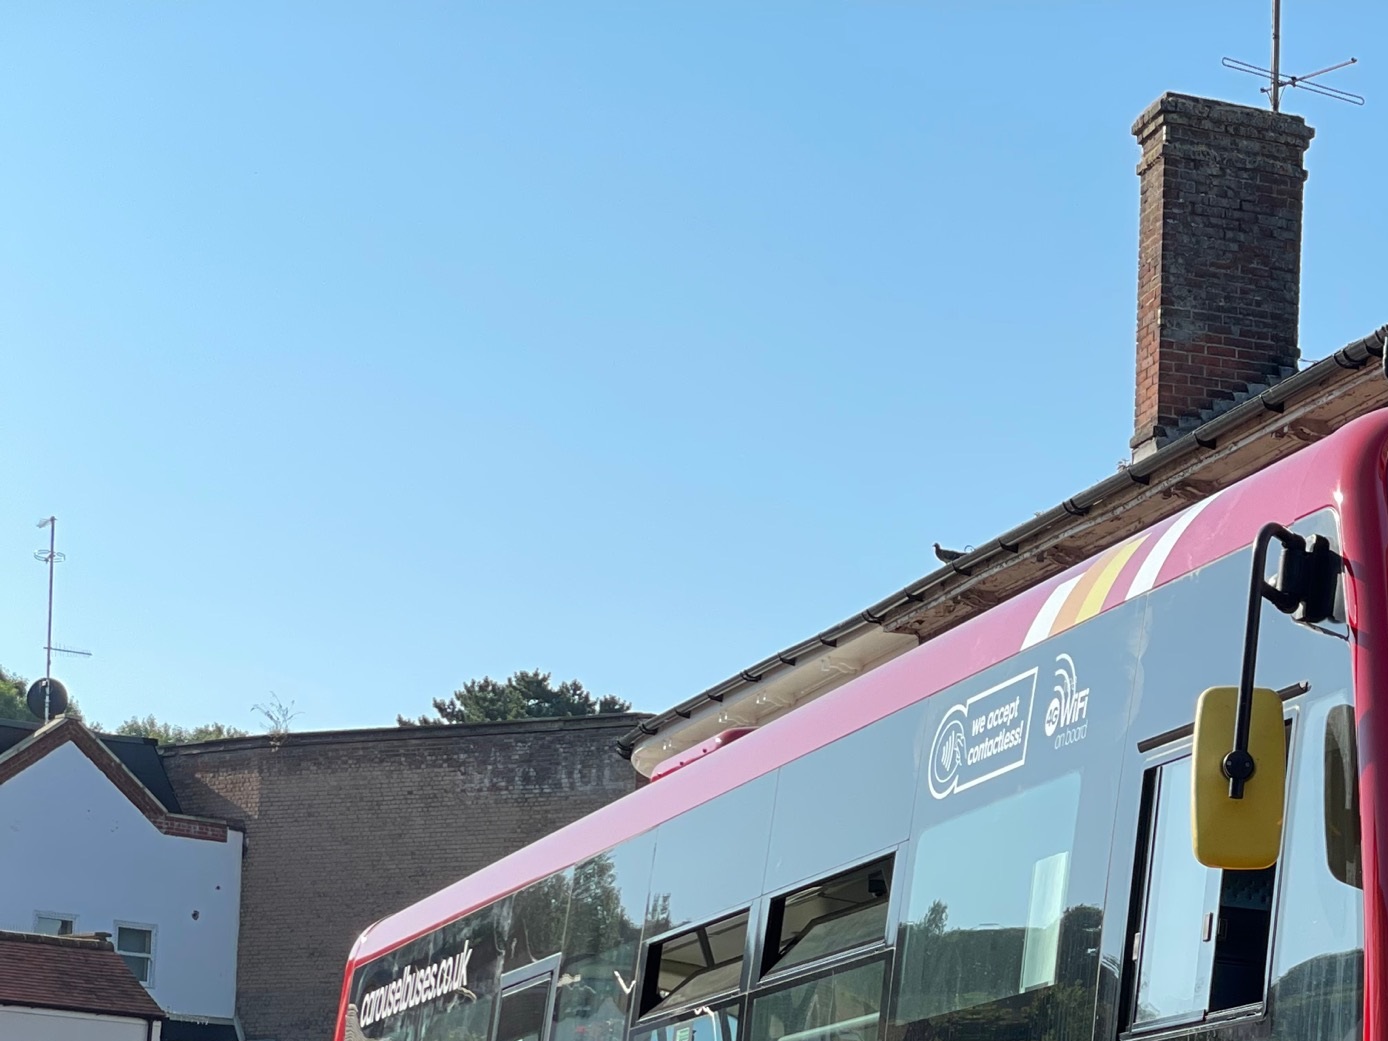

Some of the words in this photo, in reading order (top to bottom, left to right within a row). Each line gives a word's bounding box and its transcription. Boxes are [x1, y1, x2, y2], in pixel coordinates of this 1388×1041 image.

[972, 715, 985, 736] we
[987, 696, 1020, 731] accept
[967, 720, 1025, 765] contactless!
[361, 939, 473, 1028] carouselbuses.co.uk
